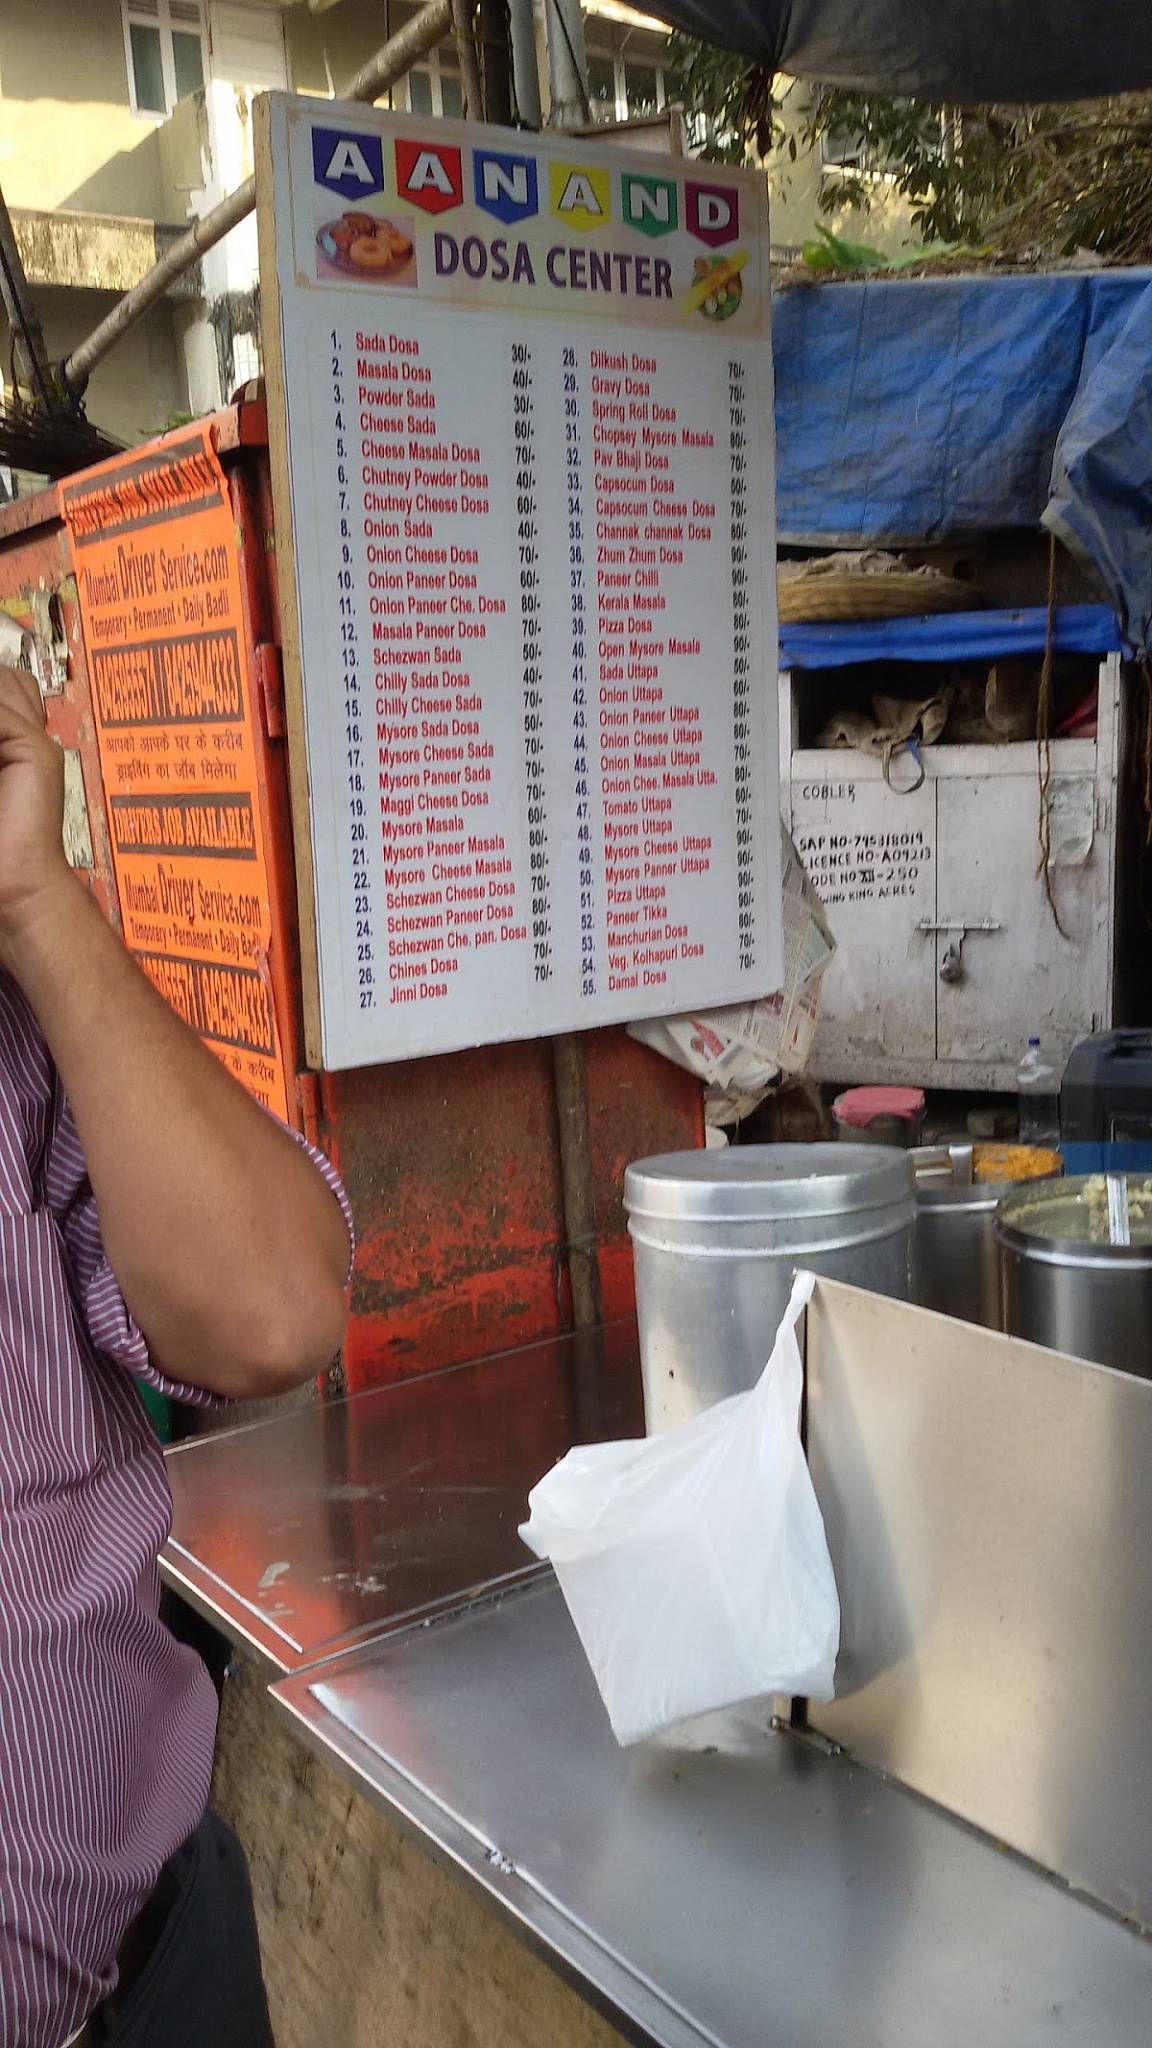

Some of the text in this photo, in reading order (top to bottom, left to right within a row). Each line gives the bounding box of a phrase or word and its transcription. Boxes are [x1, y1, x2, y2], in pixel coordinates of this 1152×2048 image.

[325, 141, 731, 230] AANAND
[434, 232, 673, 299] DOSA CENTER
[330, 329, 342, 351] 1.
[355, 331, 386, 352] Sada
[388, 334, 420, 356] Dosa
[590, 349, 629, 371] Dilkush
[631, 353, 657, 374] Dosa
[333, 383, 345, 404] 3.
[358, 385, 404, 407] Powder
[406, 389, 436, 409] Sada
[591, 399, 626, 423] Spring
[629, 402, 649, 421] Roll
[651, 403, 677, 423] Dosa
[336, 437, 348, 458] 5.
[361, 438, 406, 460] Cheese
[408, 441, 449, 461] Masala
[451, 442, 481, 463] Dosa
[593, 448, 613, 467] Pav
[616, 450, 642, 472] Bhaji
[644, 452, 669, 470] Dosa
[338, 491, 350, 511] 7.
[363, 491, 413, 516] Chutney
[415, 494, 458, 513] Cheese
[460, 495, 490, 514] Dosa
[652, 499, 688, 517] Cheese
[692, 499, 716, 518] Dosa
[341, 543, 353, 564] 9.
[366, 544, 403, 564] Onion
[405, 545, 448, 564] Cheese
[449, 545, 479, 564] Dosa
[84, 541, 230, 608] Mumbai Driver Service.com
[596, 569, 632, 588] Paneer
[634, 569, 659, 587] Chilli
[90, 588, 231, 640] Temporary Permanent Daily Badli
[340, 622, 358, 642] 12.
[372, 621, 413, 640] Masala
[415, 621, 455, 639] Paneer
[457, 620, 487, 639] Dosa
[598, 640, 625, 661] Open
[629, 639, 665, 660] Mysore
[668, 637, 701, 655] Masala
[163, 635, 240, 718] 8425944333
[343, 673, 361, 692] 14.
[374, 672, 408, 694] Chilly
[411, 671, 439, 689] Sada
[441, 670, 471, 688] Dosa
[175, 735, 190, 753] घर
[196, 730, 207, 751] के
[156, 763, 171, 781] का
[600, 754, 630, 772] Onion
[633, 752, 667, 769] Masala
[670, 750, 701, 767] Uttapa
[348, 773, 365, 792] 18.
[378, 771, 421, 794] Mysore
[422, 769, 462, 786] Paneer
[464, 765, 492, 783] Sada
[802, 784, 855, 802] COBLER
[113, 806, 255, 850] DRIVERS JOB AVAILABLE
[352, 847, 370, 866] 21.
[382, 844, 424, 866] Mysore
[426, 841, 465, 857] Paneer
[467, 834, 505, 853] Masala
[810, 874, 836, 887] ODE
[124, 863, 263, 929] Mumbai Driver Service.com
[354, 895, 372, 914] 23.
[386, 891, 443, 910] Schezwan
[445, 885, 486, 903] Cheese
[488, 881, 516, 897] Dosa
[607, 888, 632, 905] Pizza
[635, 885, 667, 901] Uttapa
[129, 917, 168, 949] Temporary
[172, 922, 214, 952] Permanent
[219, 930, 240, 962] Daily
[357, 943, 374, 962] 25.
[388, 937, 445, 957] Schezwan
[500, 924, 527, 942] Dosa
[632, 944, 678, 966] Kolhapuri
[680, 943, 705, 959] Dosa
[359, 990, 377, 1009] 27.
[419, 982, 448, 1000] Dosa
